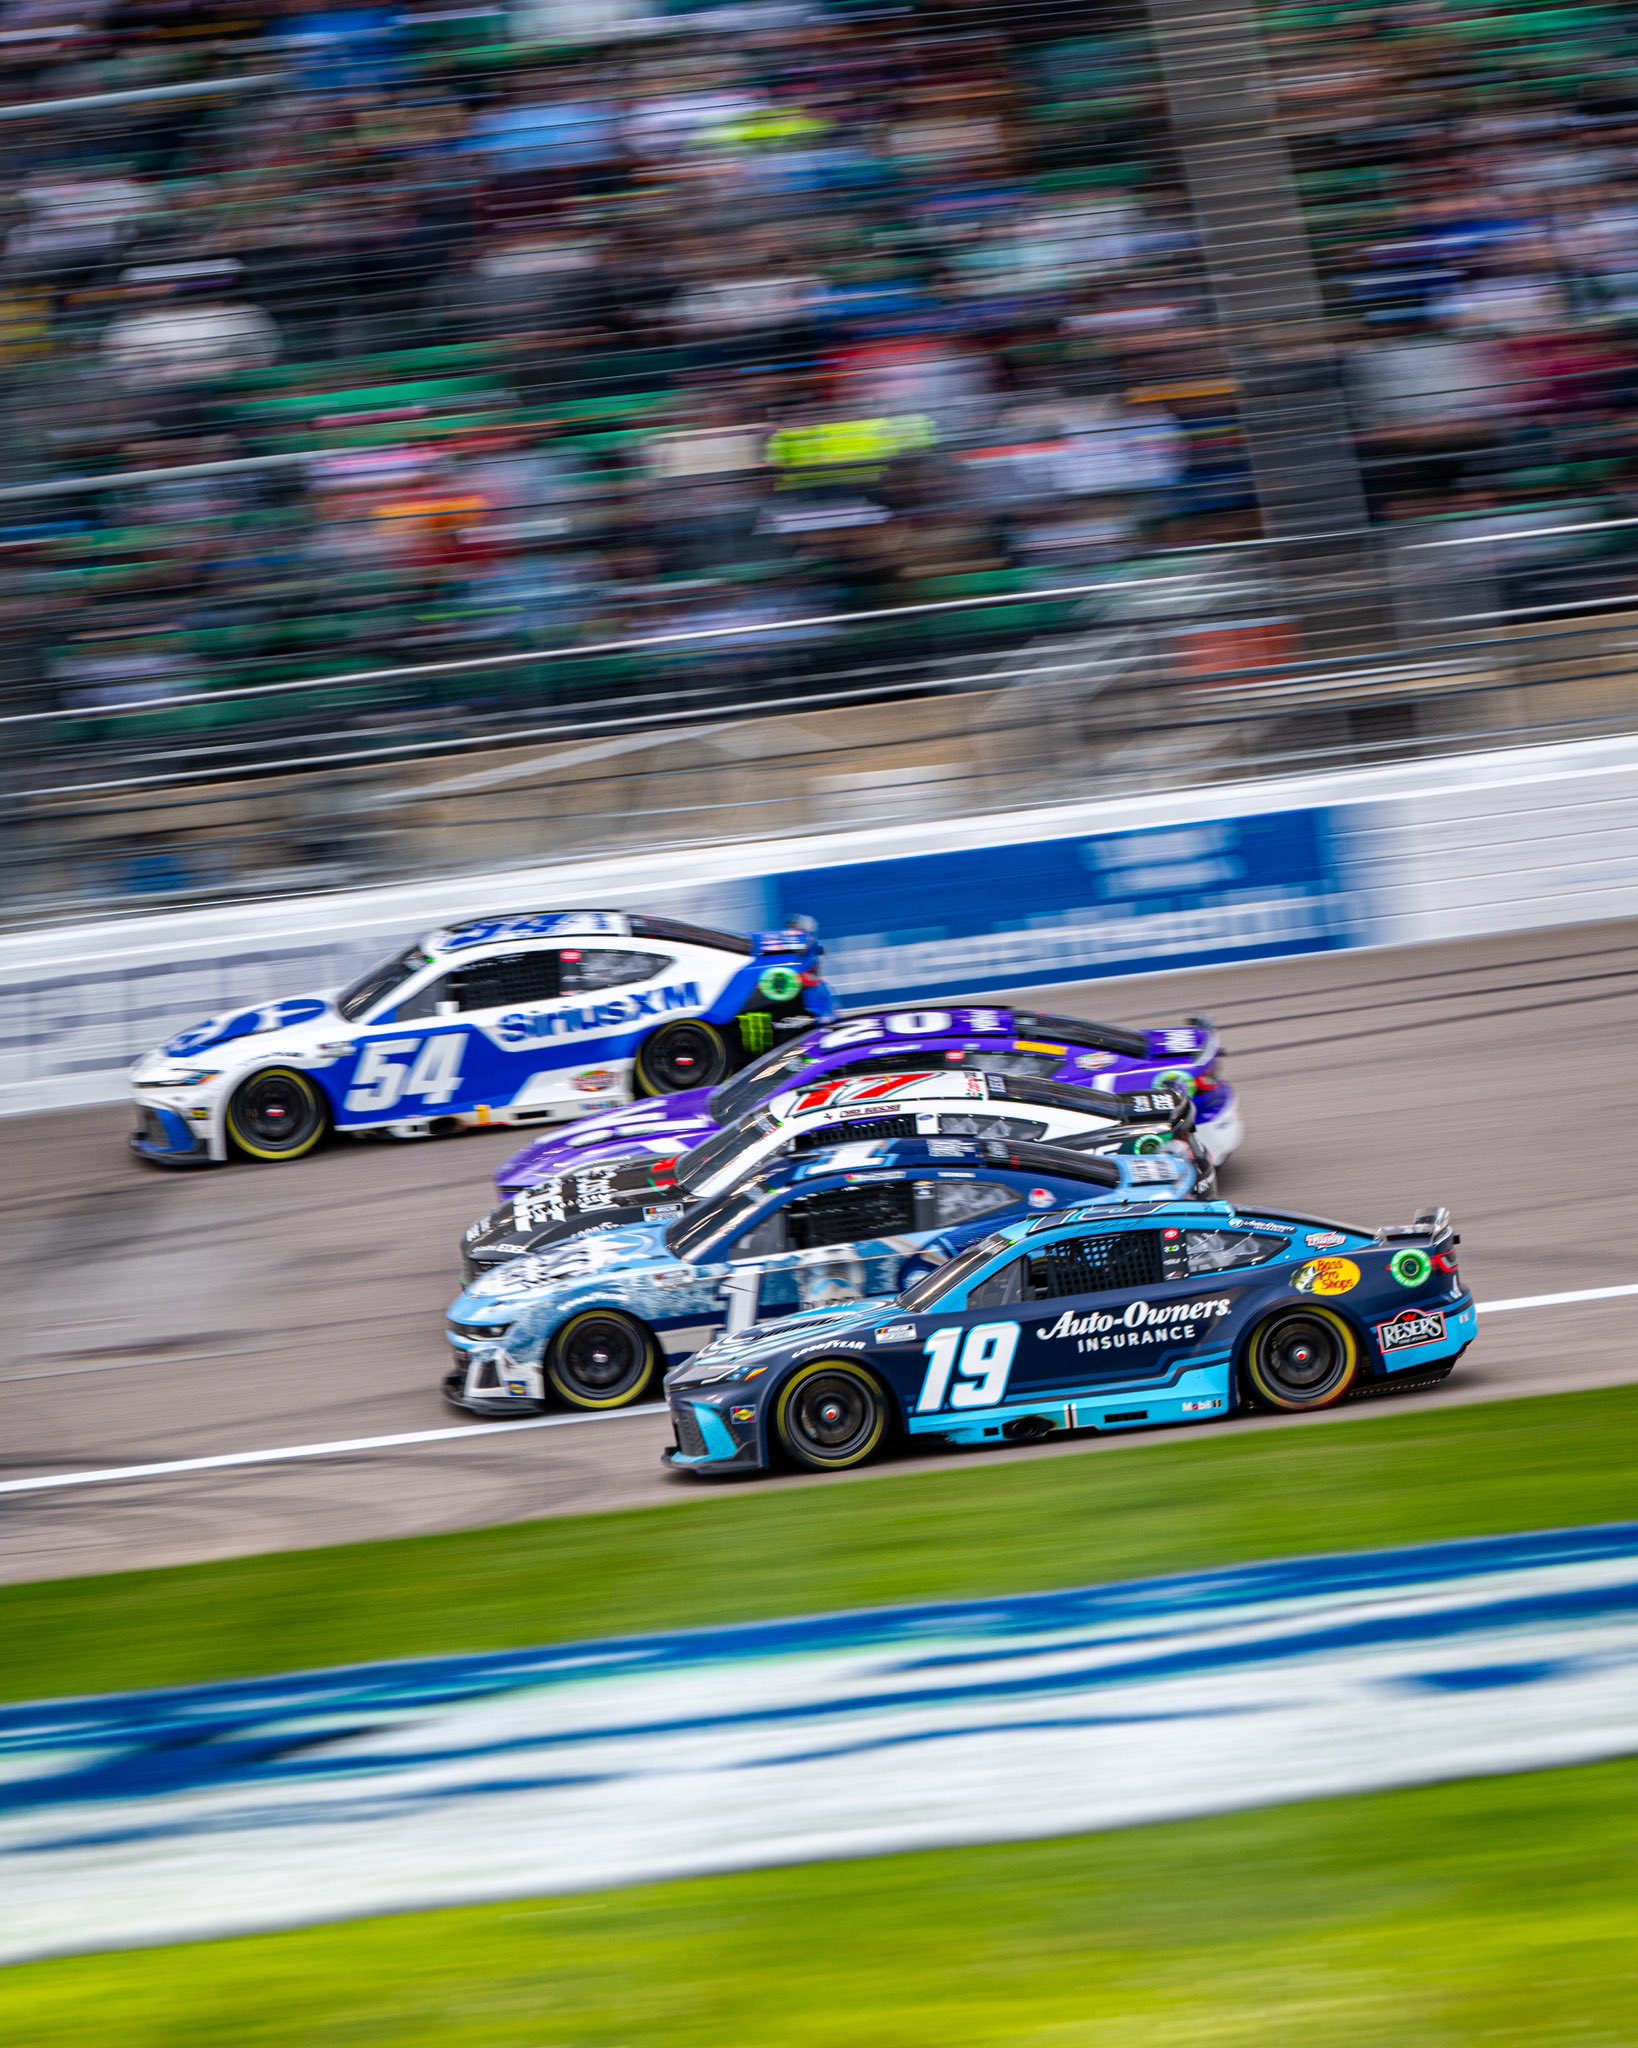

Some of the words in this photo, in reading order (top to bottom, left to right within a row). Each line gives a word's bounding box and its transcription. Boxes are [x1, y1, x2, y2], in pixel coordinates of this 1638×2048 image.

[500, 981, 702, 1042] SiriusXM
[819, 1012, 951, 1050] 20
[343, 1033, 469, 1112] 54
[785, 1072, 942, 1117] 17
[1316, 1260, 1343, 1271] Bass
[1319, 1271, 1339, 1281] Pro
[1322, 1279, 1354, 1291] Shops
[716, 1264, 760, 1336] 1
[1036, 1298, 1230, 1340] Auto-Owners
[791, 1339, 866, 1358] GOODYEAR
[1077, 1324, 1196, 1354] INSURANCE
[916, 1321, 1021, 1412] 19
